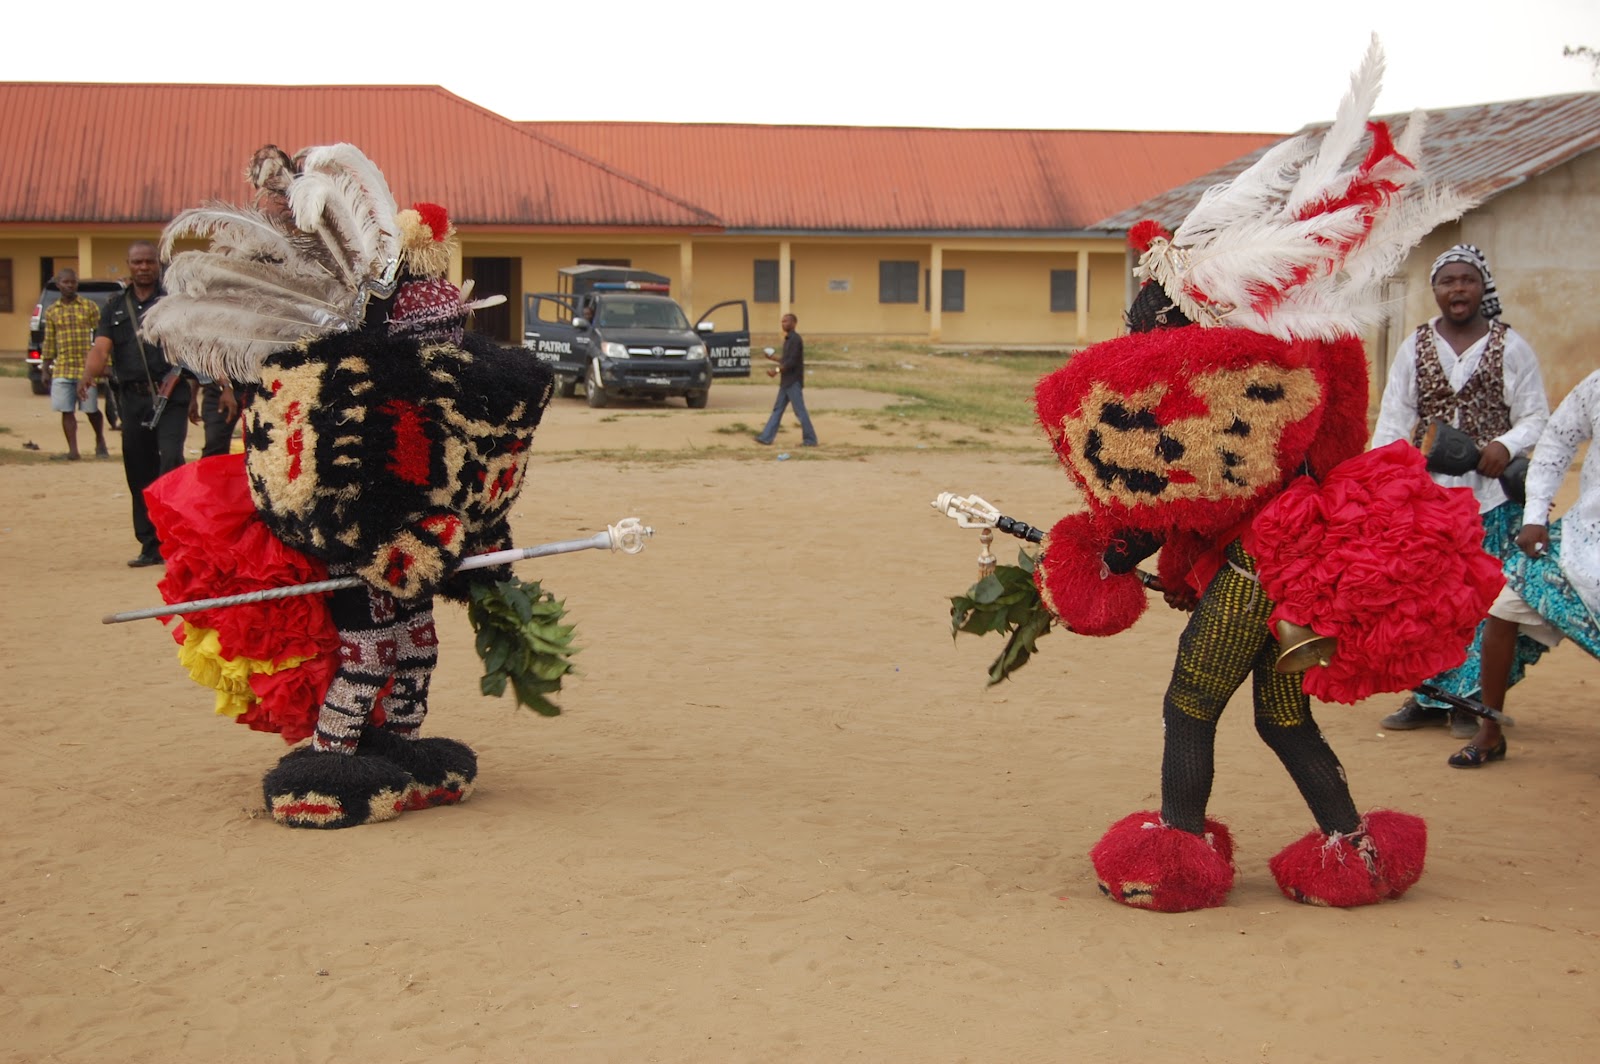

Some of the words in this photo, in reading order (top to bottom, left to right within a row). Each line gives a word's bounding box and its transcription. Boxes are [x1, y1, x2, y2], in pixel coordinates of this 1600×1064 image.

[539, 340, 572, 354] PATROL
[711, 347, 729, 358] ANTI
[718, 358, 737, 367] EKET
